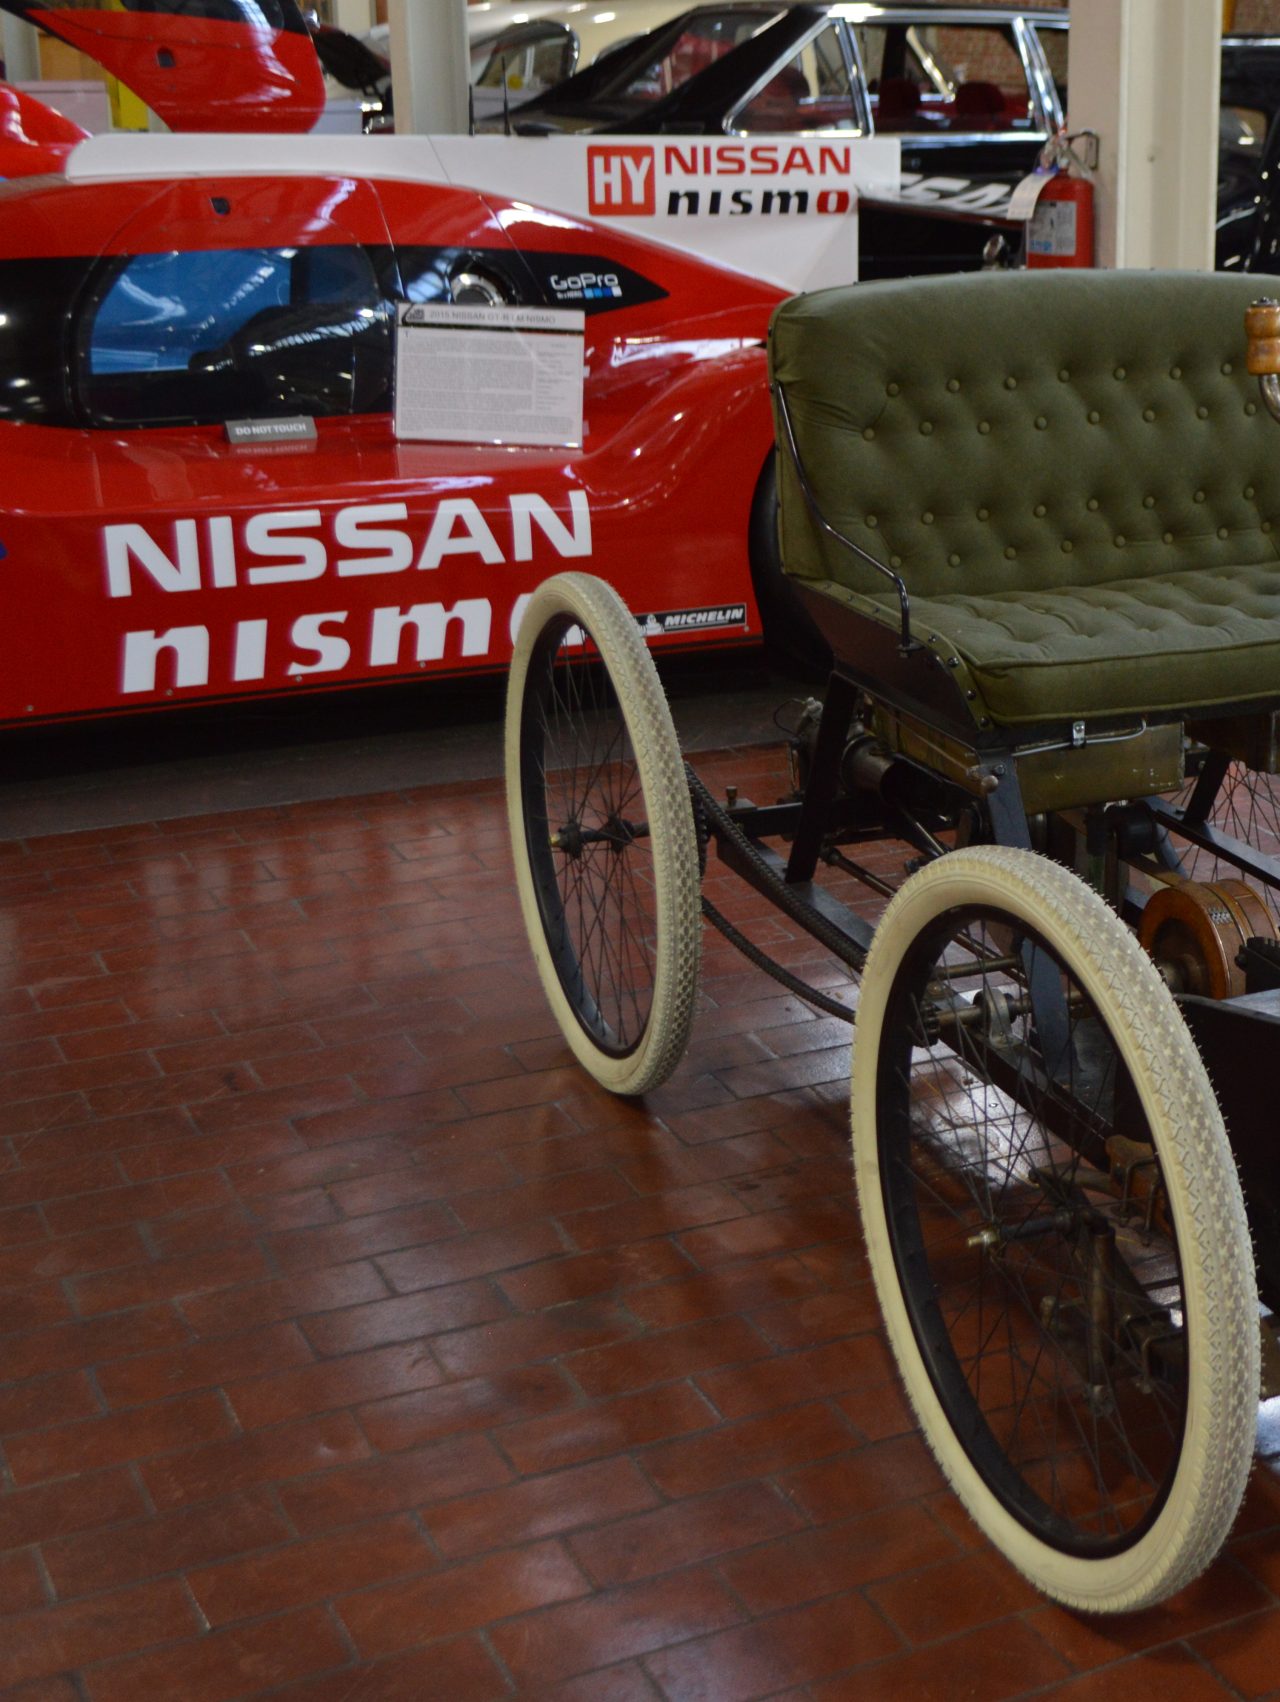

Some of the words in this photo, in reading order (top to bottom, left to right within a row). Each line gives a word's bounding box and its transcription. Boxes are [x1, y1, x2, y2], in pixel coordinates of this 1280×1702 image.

[664, 145, 850, 175] NISSAN
[593, 155, 651, 205] HY
[667, 190, 849, 216] nismo
[550, 272, 619, 291] GoPro
[430, 309, 450, 319] 2015
[452, 310, 486, 321] NISSAN
[235, 427, 252, 436] DO
[252, 425, 272, 435] NOT
[272, 422, 307, 433] TOUCH
[102, 490, 594, 599] NISSAN
[664, 608, 744, 626] MICHELIN
